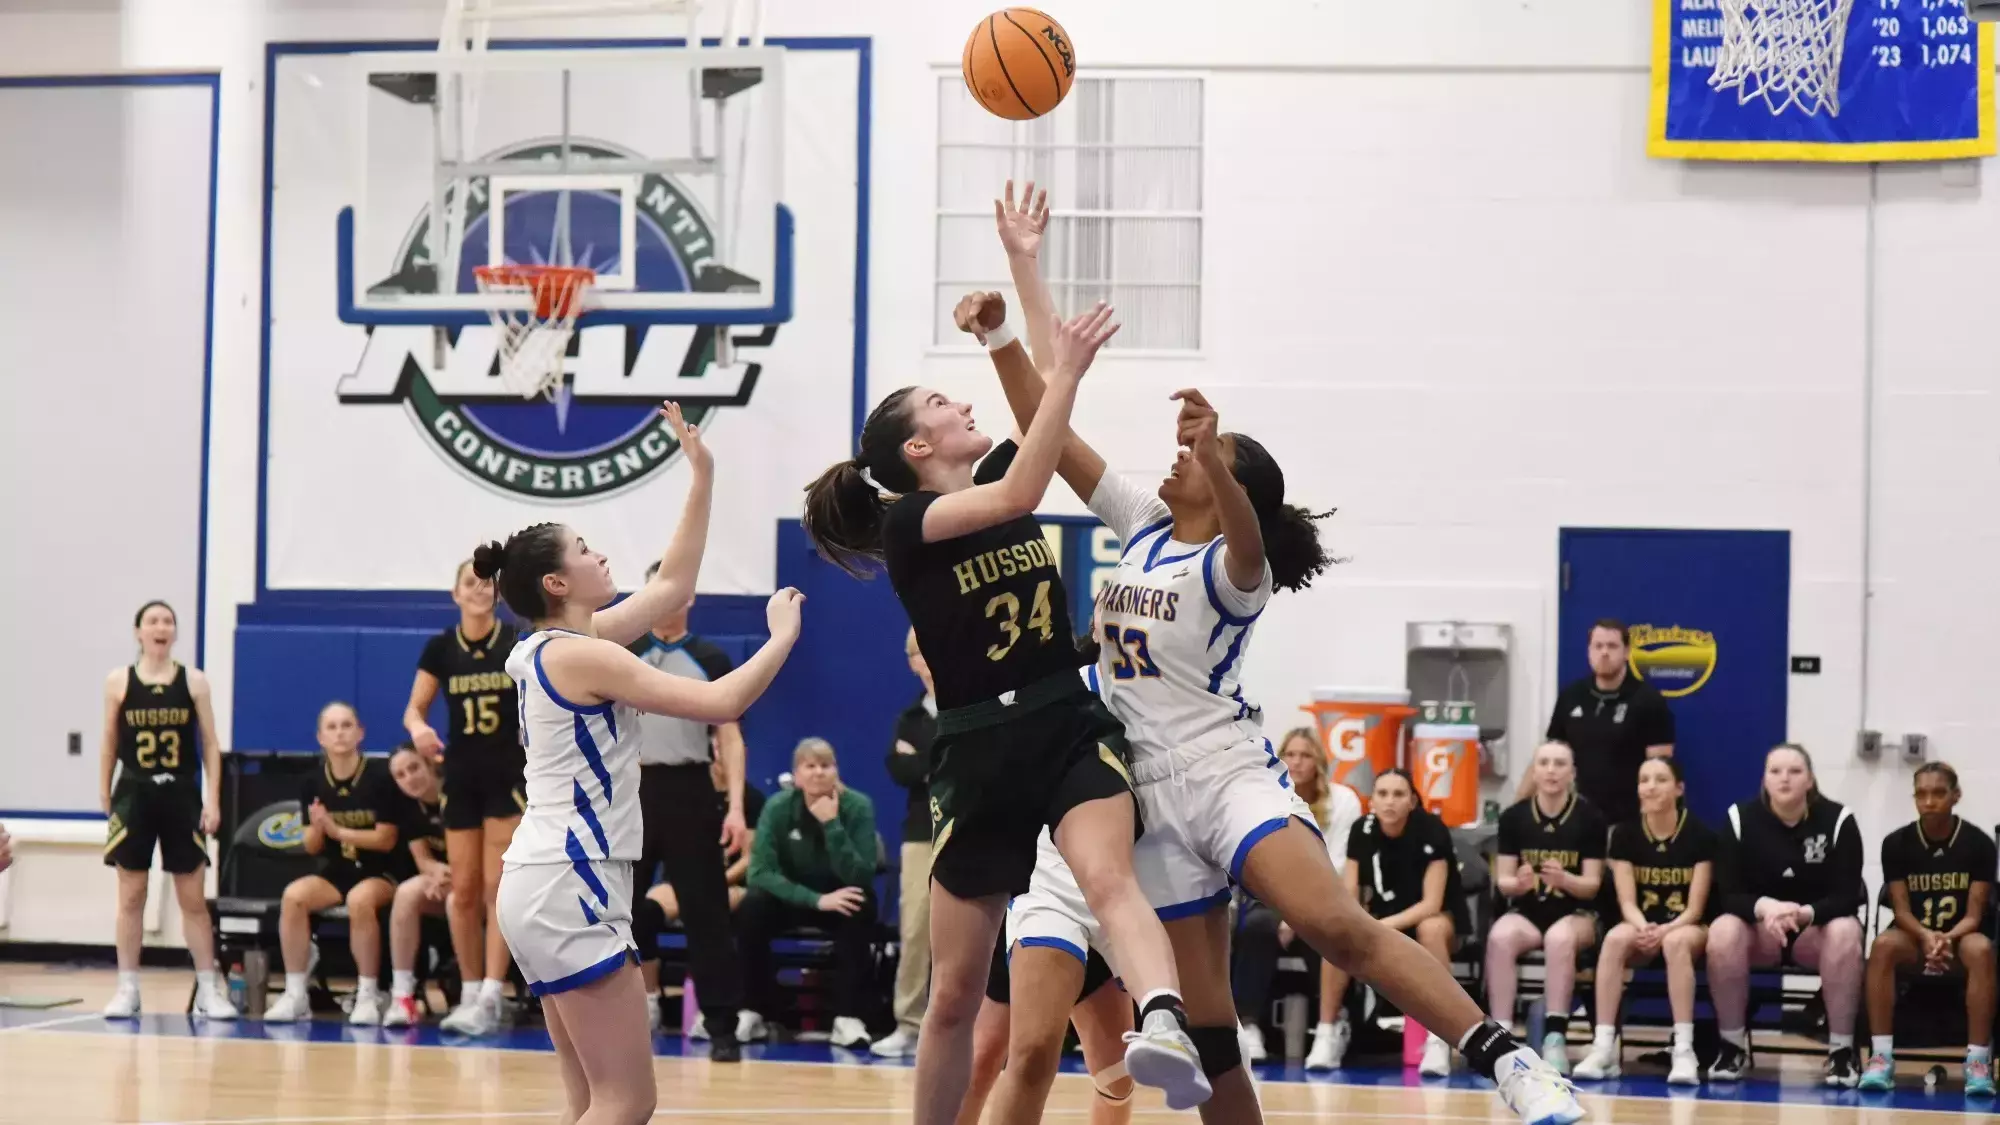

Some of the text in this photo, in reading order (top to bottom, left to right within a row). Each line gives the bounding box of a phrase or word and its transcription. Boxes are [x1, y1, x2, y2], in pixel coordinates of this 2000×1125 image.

[1872, 17, 1900, 37] '20
[1922, 16, 1968, 39] 1,063
[1041, 25, 1074, 78] NCAA
[1872, 45, 1901, 67] '23
[1922, 43, 1971, 69] 1,074
[953, 538, 1056, 595] HUSSON
[985, 580, 1053, 661] 34
[125, 708, 189, 727] HUSSON
[463, 695, 499, 735] 15
[136, 730, 180, 769] 23
[1329, 718, 1366, 761] G
[1426, 746, 1450, 773] G
[1907, 872, 1969, 892] HUSSON
